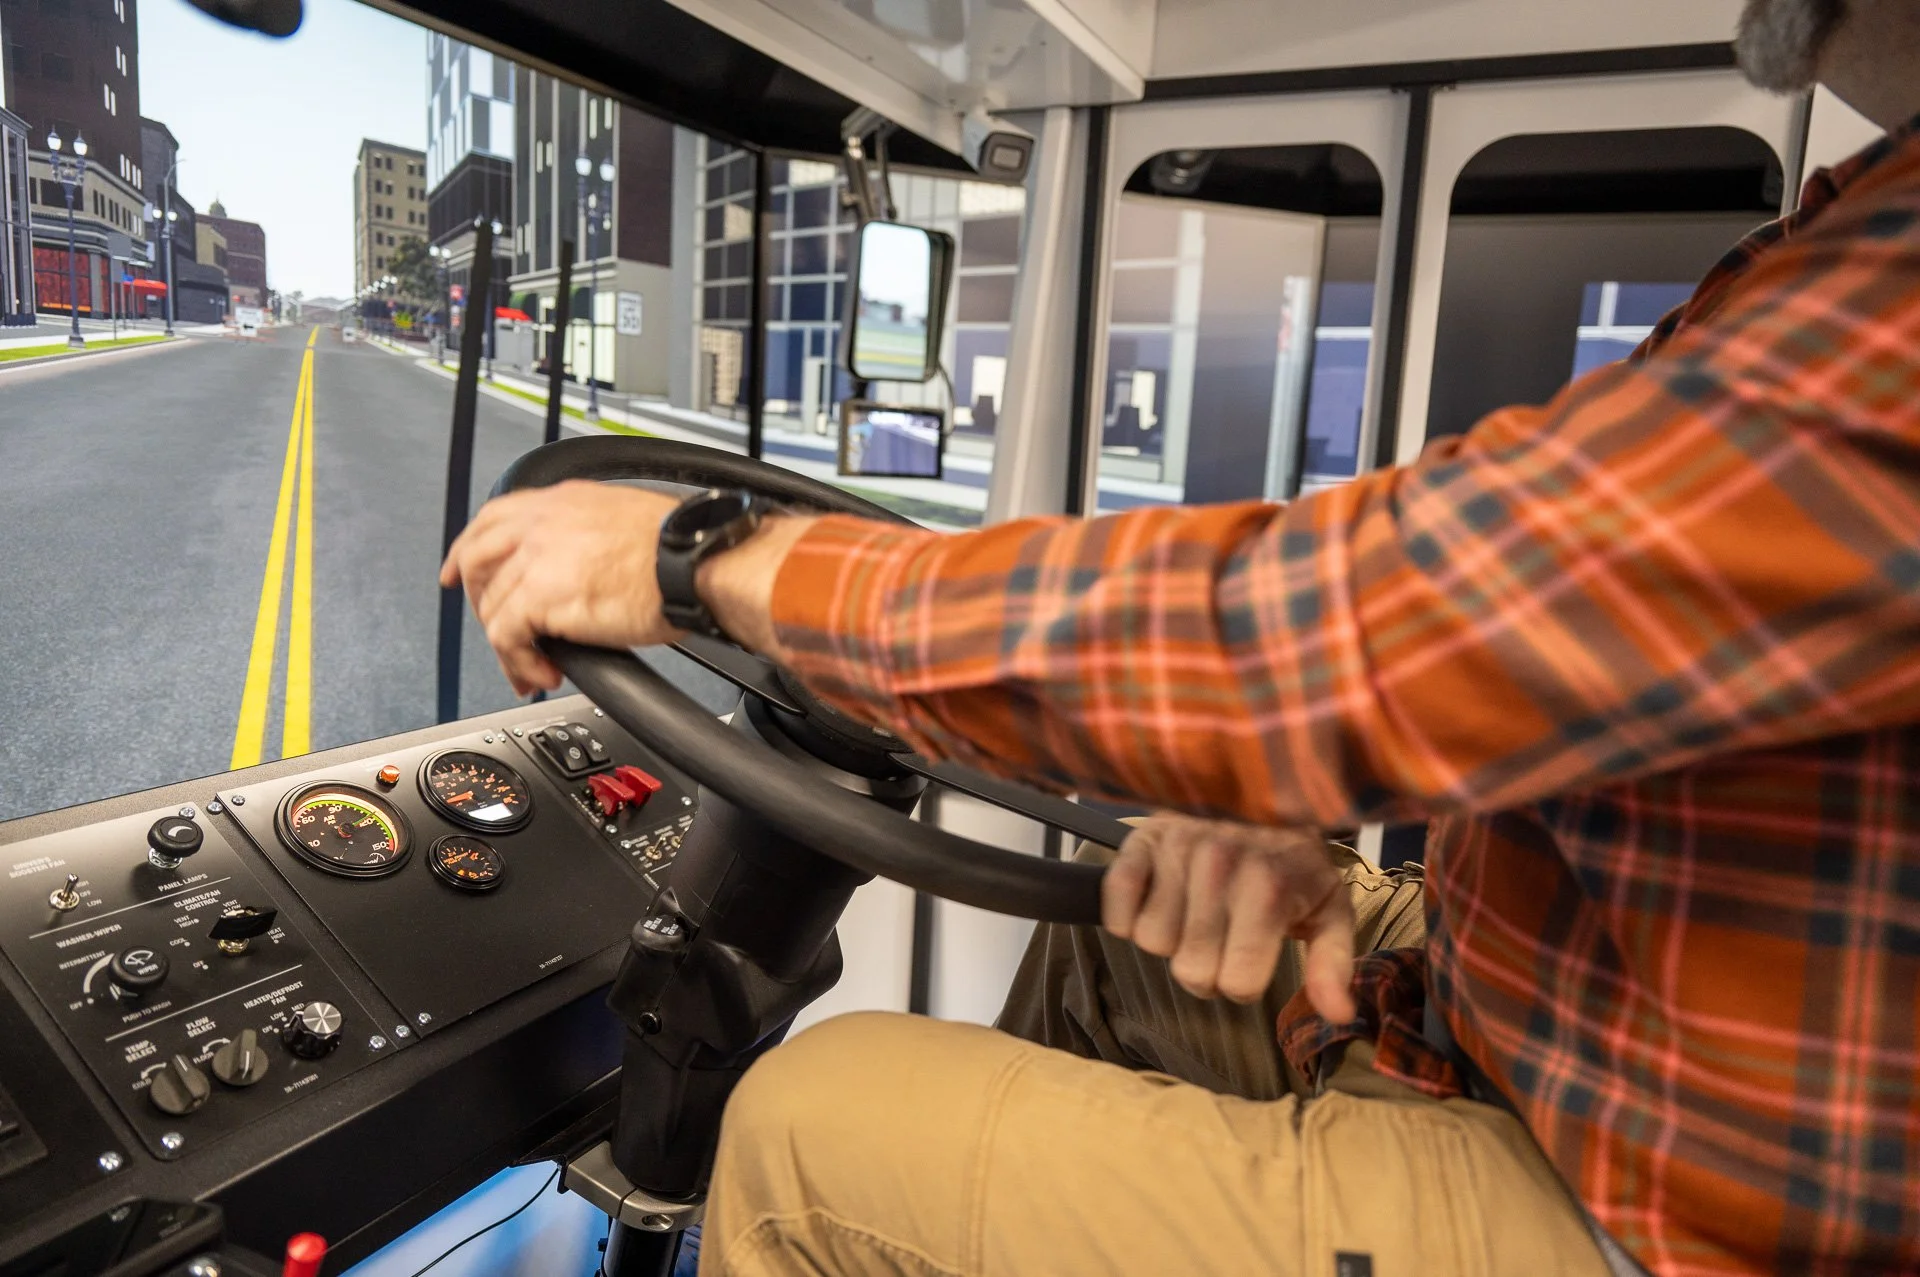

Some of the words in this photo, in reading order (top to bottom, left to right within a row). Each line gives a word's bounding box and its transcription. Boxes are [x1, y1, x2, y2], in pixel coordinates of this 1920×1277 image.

[328, 805, 342, 814] 90
[301, 815, 316, 825] 60
[372, 841, 387, 851] 150
[158, 881, 183, 892] PANEL
[183, 873, 208, 885] LAMPS
[86, 898, 102, 907] LOW
[173, 889, 222, 908] CLIMATE/FAN
[185, 897, 219, 911] CONTROL
[222, 899, 238, 908] VENT
[174, 915, 190, 924] VENT
[179, 920, 195, 928] HIGH
[56, 924, 122, 948] WASHER-WIPER
[267, 927, 282, 936] HEAT
[271, 932, 286, 941] HIGH
[169, 937, 186, 946] COOL
[59, 950, 106, 970] INTERMITTENT
[137, 963, 158, 975] WIPER
[243, 981, 304, 1010] HEATER/DEFROST
[271, 995, 287, 1006] FAN
[122, 1011, 142, 1023] PUSH
[142, 1007, 152, 1016] TO
[152, 1000, 172, 1013] WASH
[270, 1011, 285, 1021] LOW
[185, 1016, 209, 1031] FLOW
[187, 1021, 217, 1038] SELECT
[125, 1045, 157, 1063] SELECT
